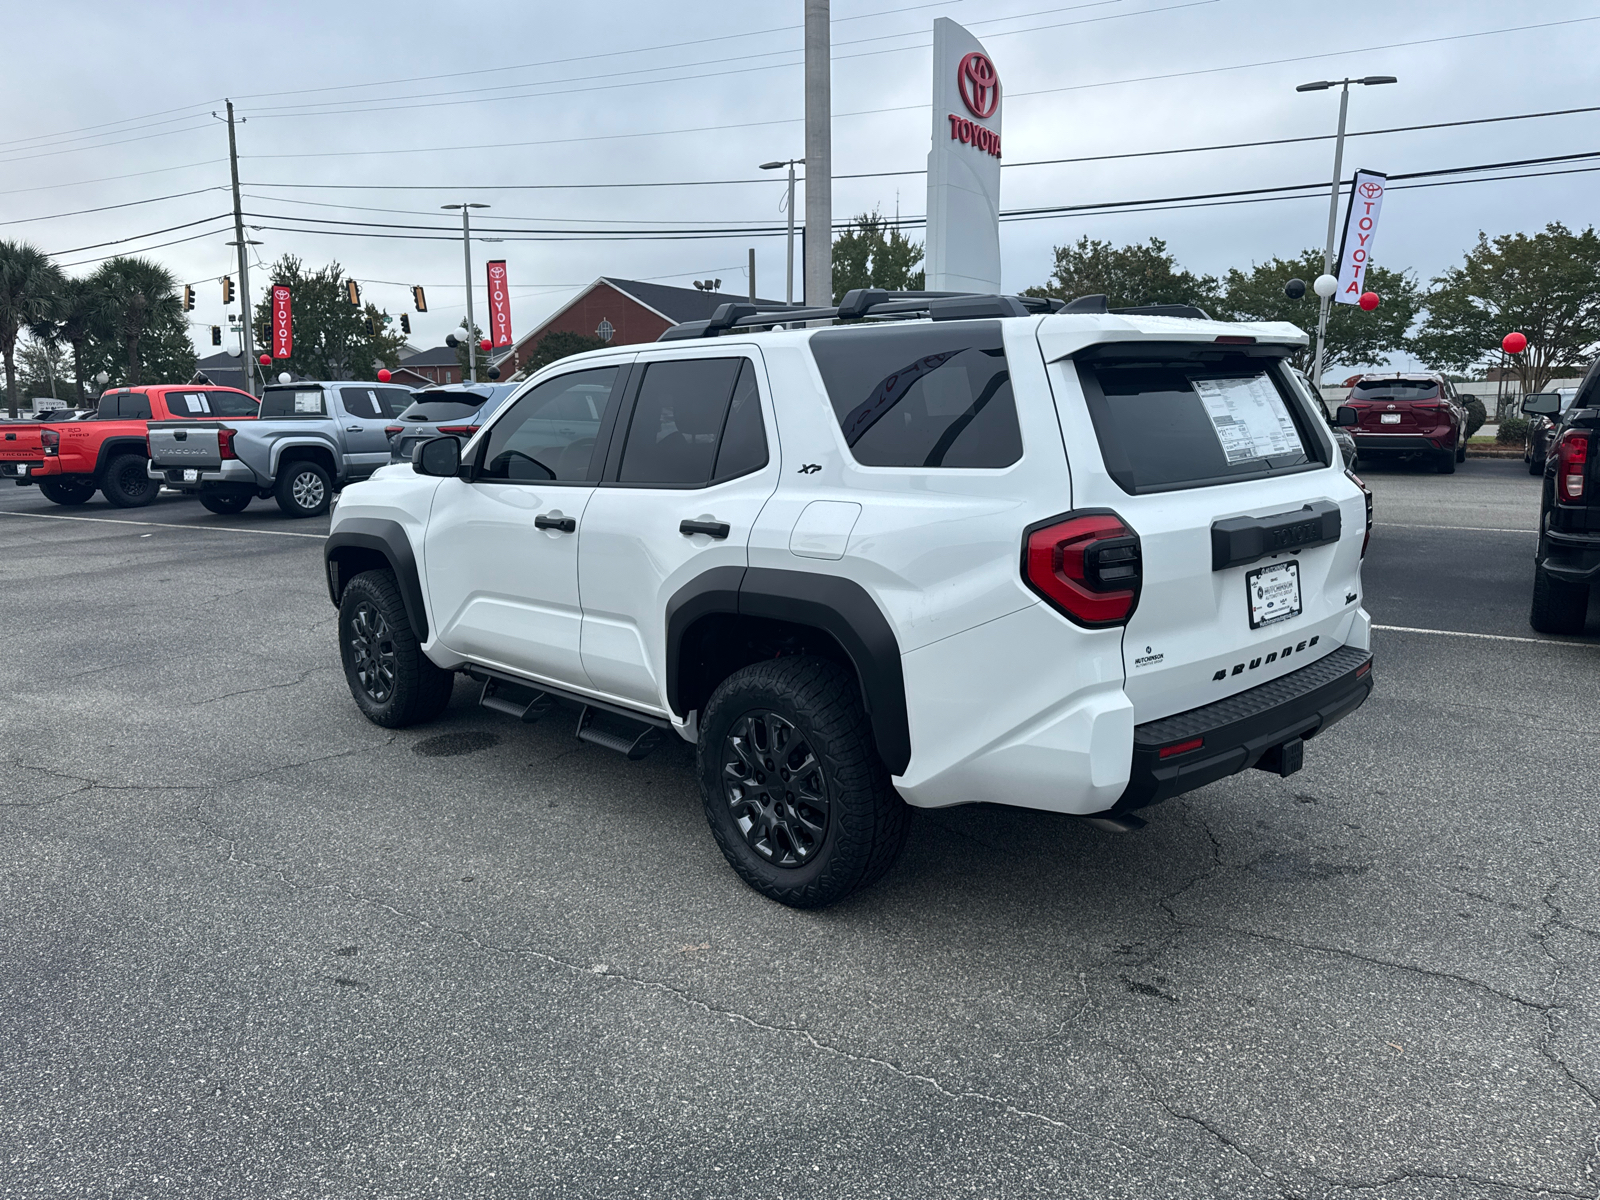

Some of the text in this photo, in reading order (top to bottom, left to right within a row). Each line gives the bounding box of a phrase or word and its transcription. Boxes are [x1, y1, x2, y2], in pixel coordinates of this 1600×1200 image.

[948, 114, 1002, 159] TOYOTA
[1345, 201, 1375, 294] TOYOTA
[278, 301, 288, 356] TOYOTA
[494, 280, 508, 344] TOYOTA
[797, 463, 823, 475] XP
[1273, 522, 1317, 547] TOYOTA
[1134, 653, 1164, 665] HUTCHINSON
[1212, 635, 1320, 682] 4RUNNER
